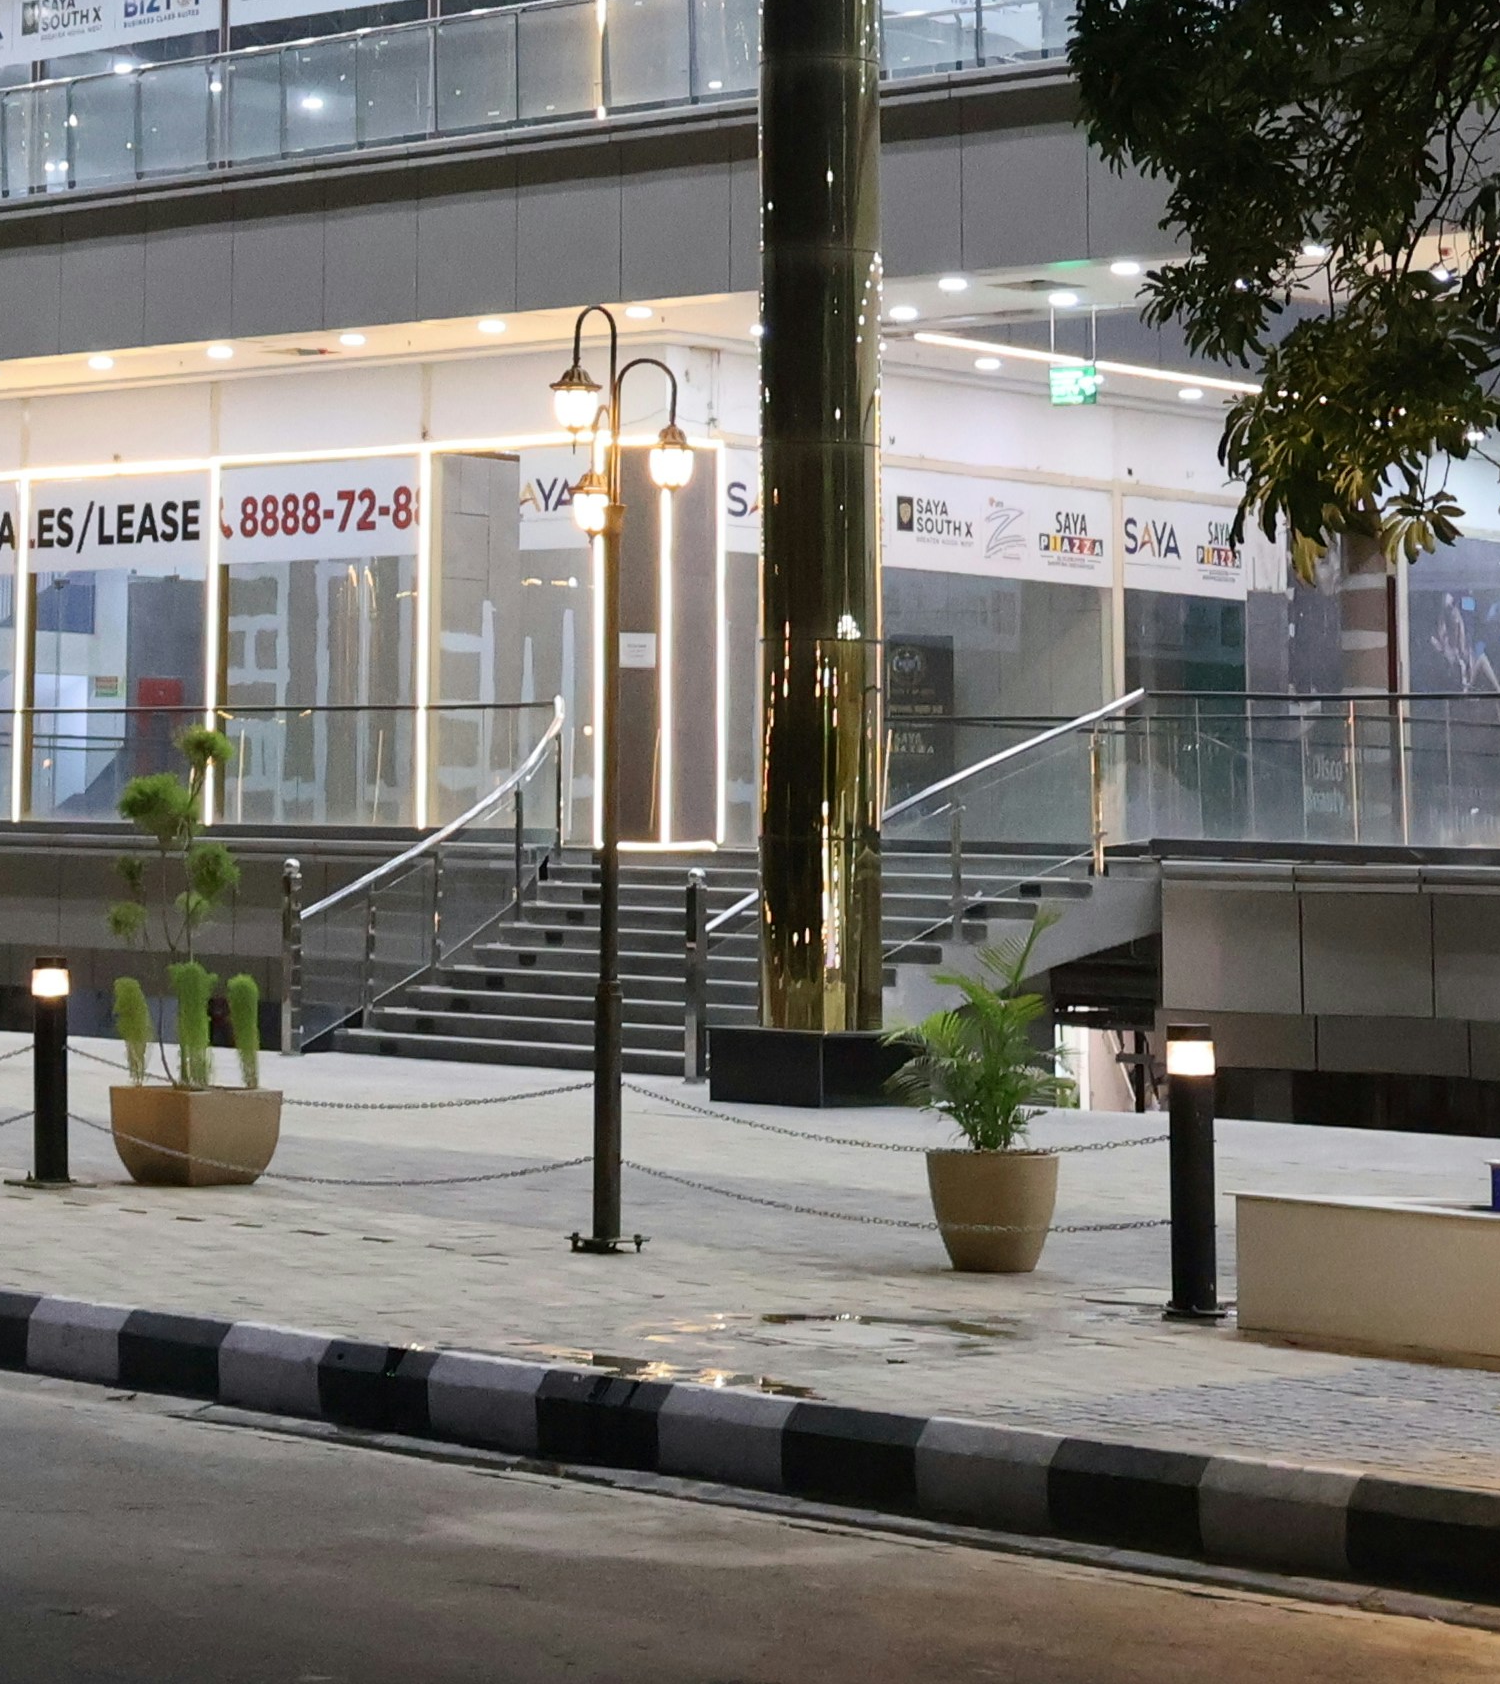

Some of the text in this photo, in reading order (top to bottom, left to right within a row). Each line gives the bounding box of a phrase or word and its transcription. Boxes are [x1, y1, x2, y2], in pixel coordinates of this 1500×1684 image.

[41, 5, 102, 32] SOUTH X
[519, 477, 574, 513] AYA
[916, 497, 949, 517] SAYA
[916, 517, 974, 538] SOUTH X
[1055, 511, 1088, 537] SAYA
[1207, 520, 1232, 546] SAYA
[1039, 533, 1103, 557] PIAZZA
[1124, 517, 1182, 560] SAYA
